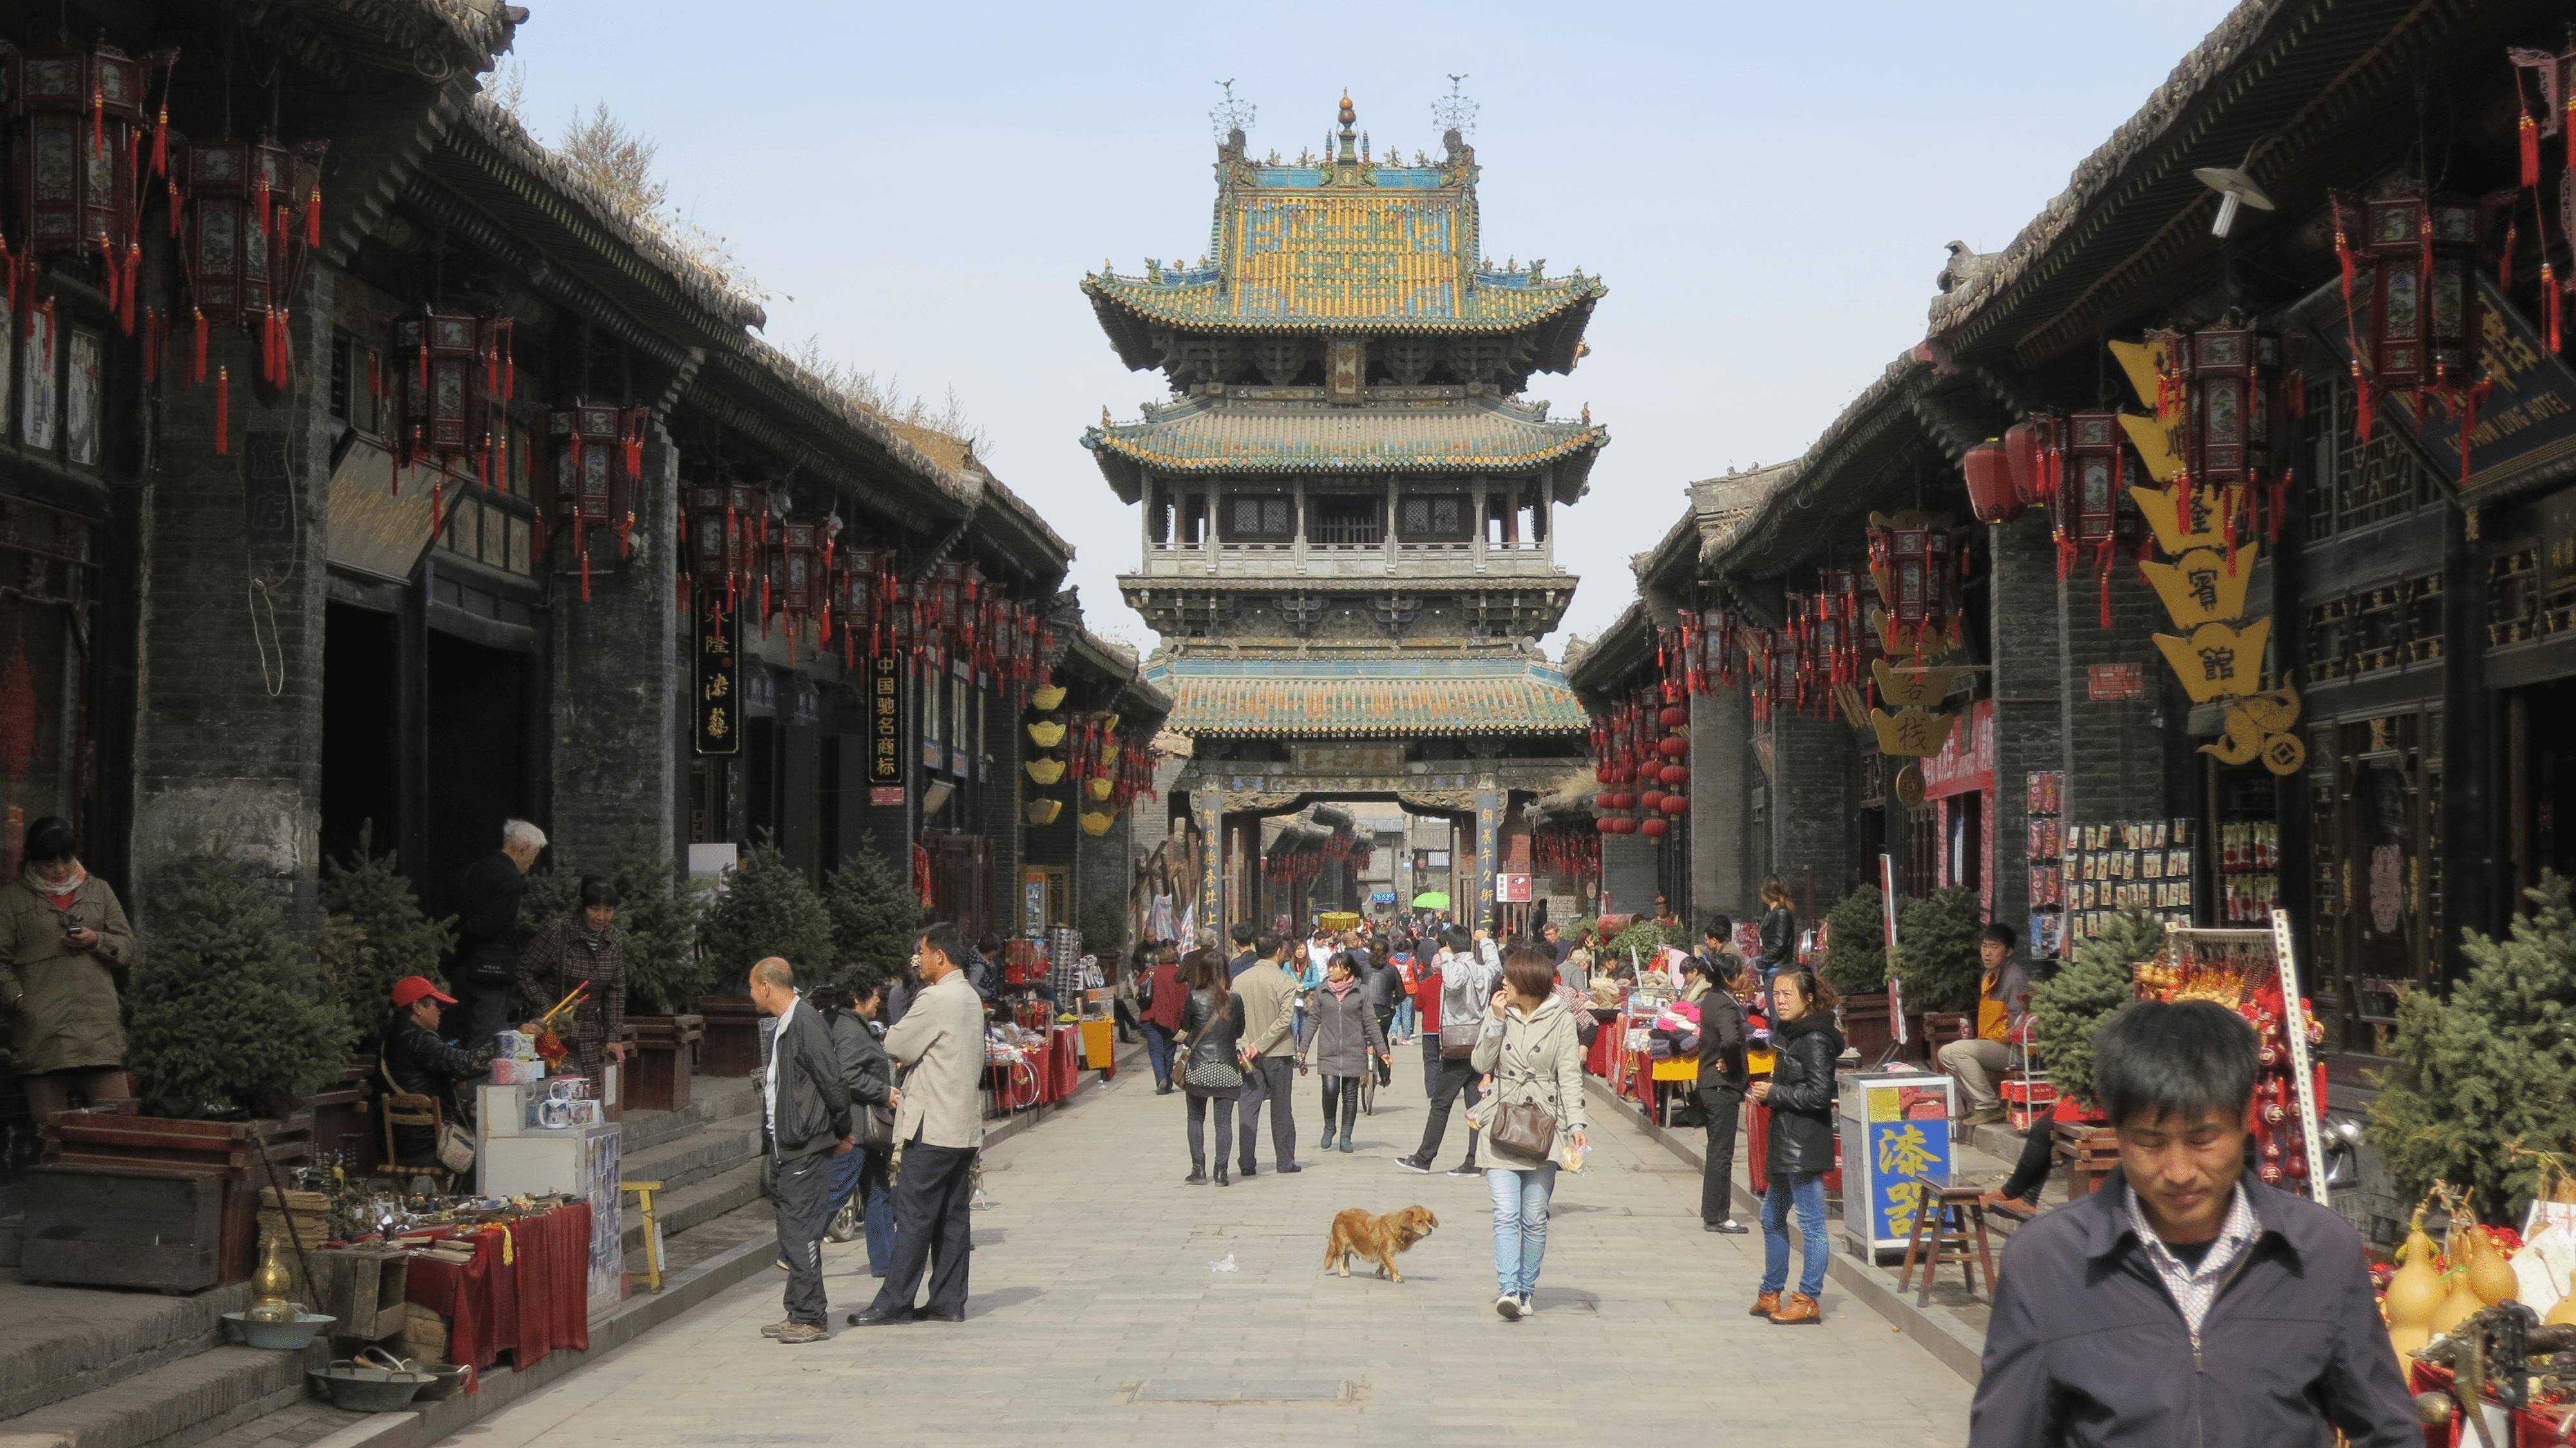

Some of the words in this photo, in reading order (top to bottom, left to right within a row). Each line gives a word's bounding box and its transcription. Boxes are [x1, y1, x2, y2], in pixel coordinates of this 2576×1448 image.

[2492, 405, 2532, 435] LONG
[2524, 391, 2572, 421] HOTEL
[251, 441, 287, 530] 旅店
[876, 657, 895, 776] 中国驰名商标
[1203, 809, 1219, 948] 賀鳳橋臺井上
[1480, 807, 1494, 937] 朝晨午夕街三
